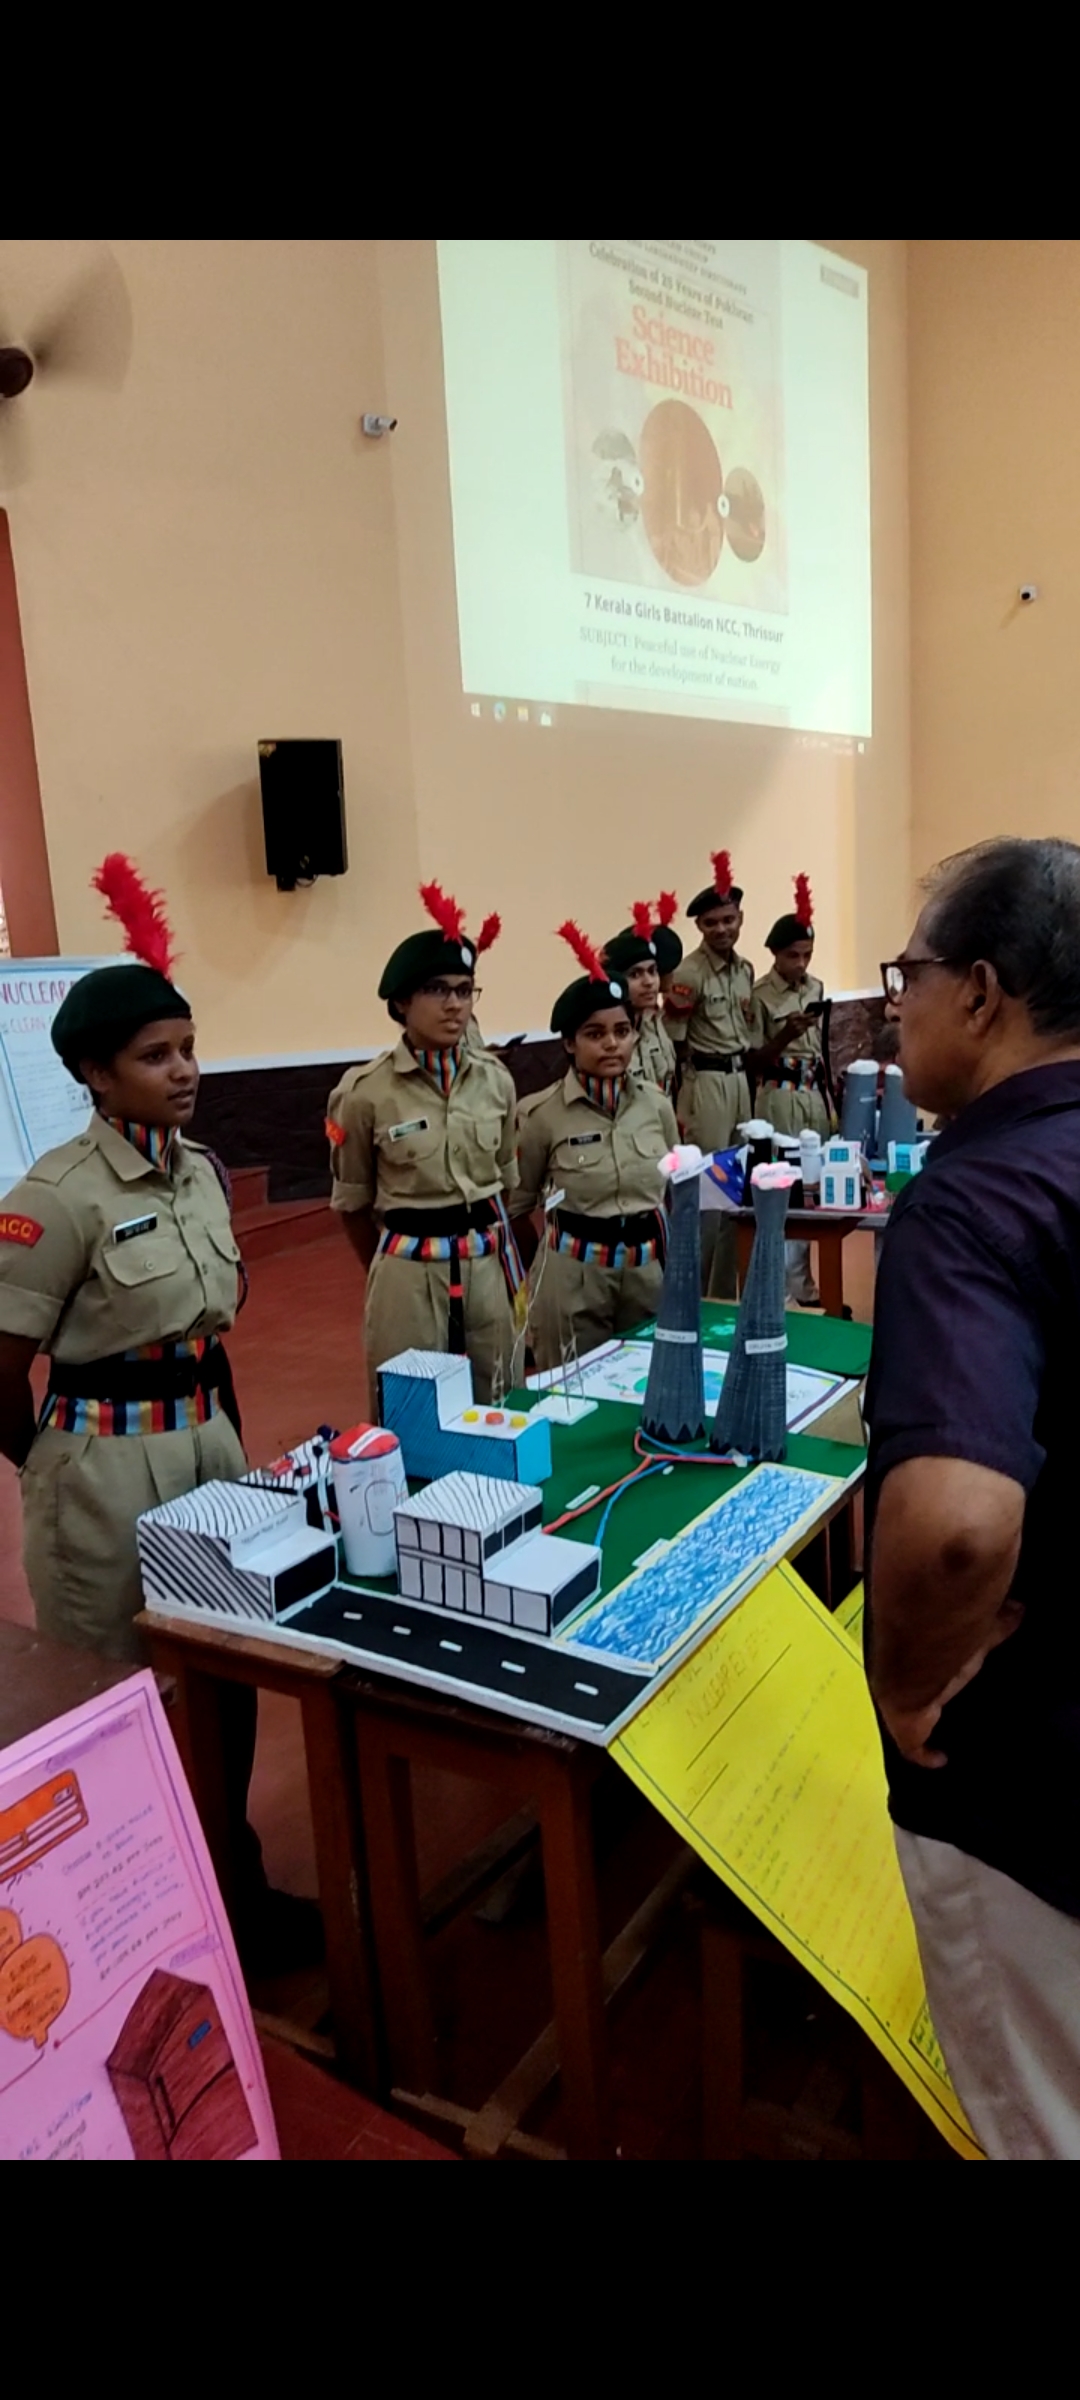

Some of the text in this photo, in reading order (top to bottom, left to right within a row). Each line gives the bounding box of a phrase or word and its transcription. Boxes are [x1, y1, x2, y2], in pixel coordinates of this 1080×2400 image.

[589, 241, 647, 280] Celebration
[650, 267, 660, 284] of
[676, 278, 701, 303] Years
[703, 292, 713, 307] of
[629, 278, 723, 330] Second Nuclear Test
[632, 303, 715, 366] Science
[614, 336, 733, 410] Exhibition
[584, 591, 784, 643] 7 Kerala Girls Battalion NCC, Thrissur
[611, 654, 627, 673] for
[629, 656, 647, 676] the
[648, 661, 713, 685] development
[715, 670, 726, 686] of
[634, 634, 678, 656] Peaceful
[680, 646, 697, 659] use
[698, 644, 709, 660] of
[711, 647, 748, 667] Nuclear
[749, 653, 781, 676] Energy
